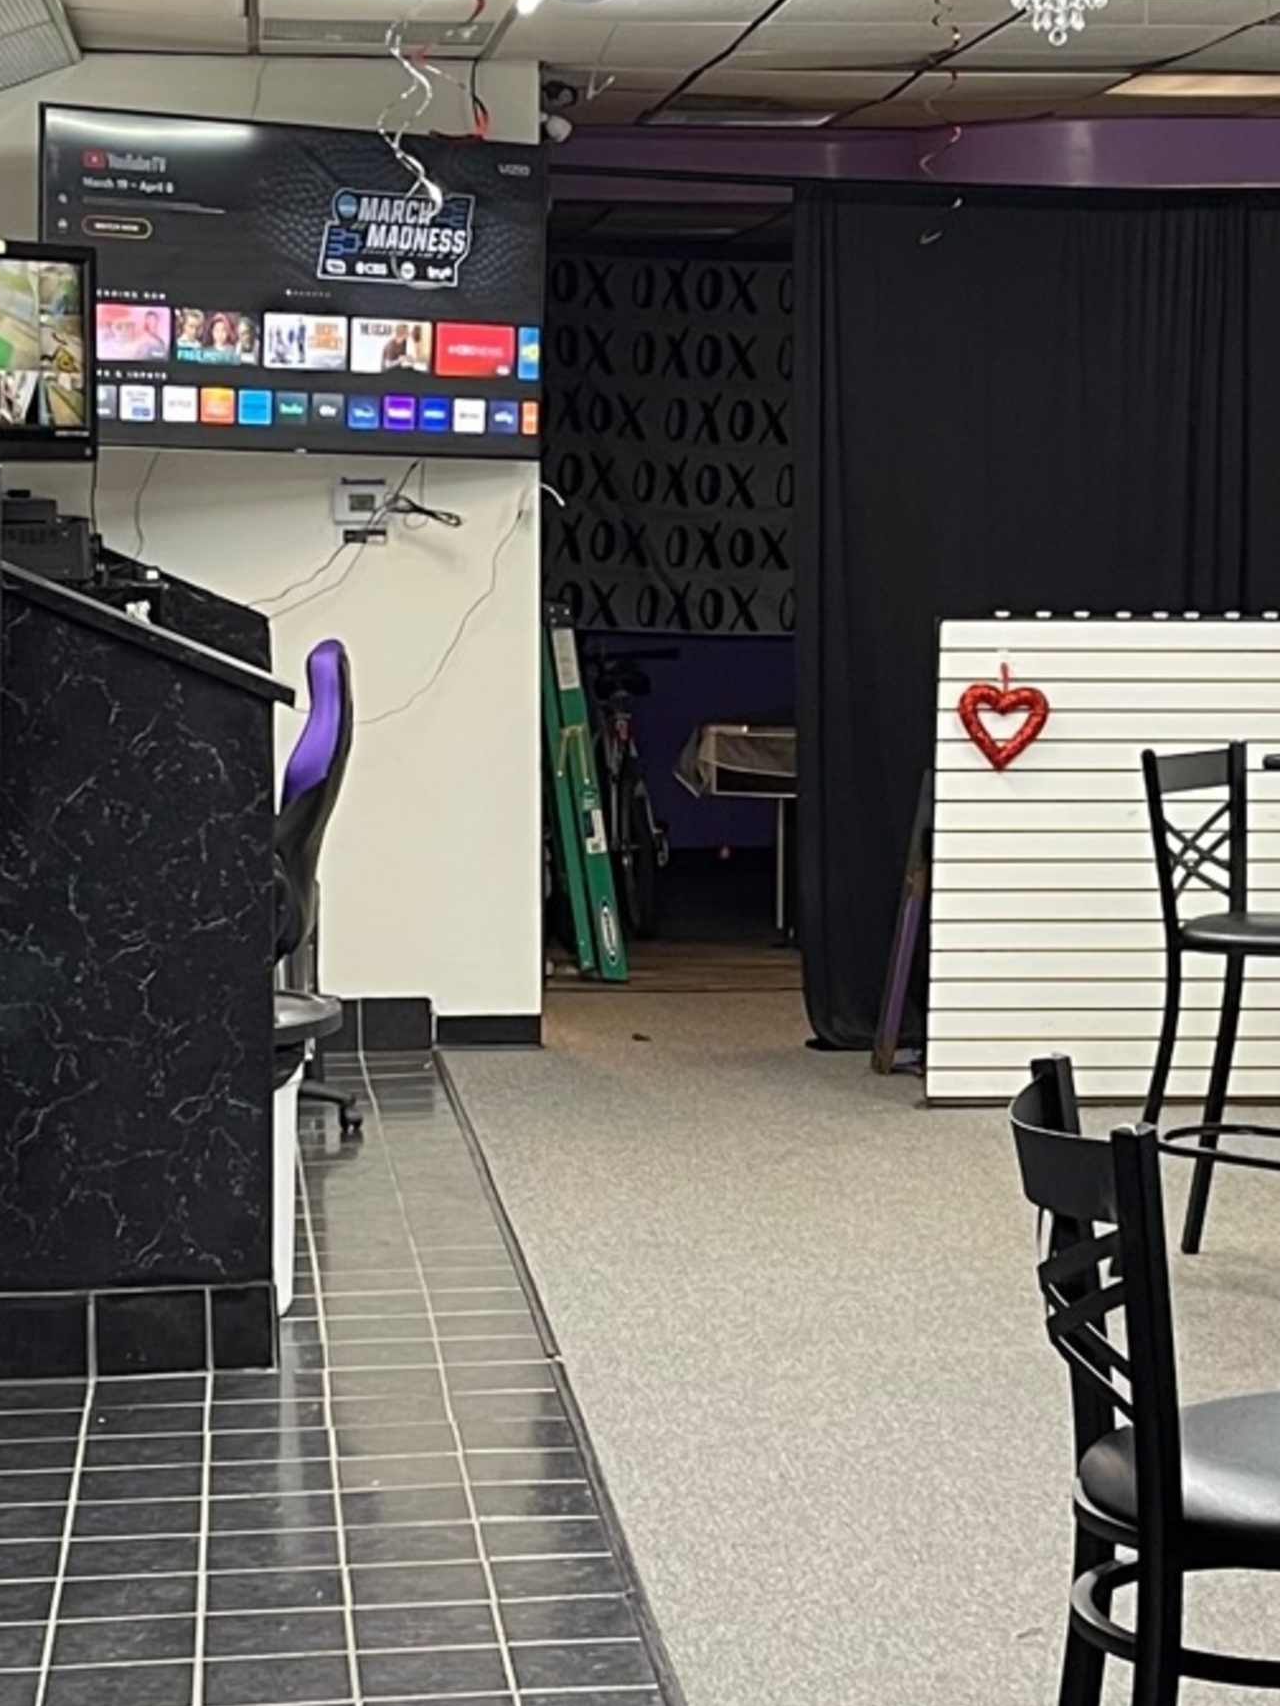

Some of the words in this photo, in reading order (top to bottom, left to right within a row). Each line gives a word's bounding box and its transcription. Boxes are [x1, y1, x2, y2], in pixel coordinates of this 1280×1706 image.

[83, 177, 114, 189] March
[139, 180, 163, 194] April
[358, 197, 433, 226] MARCH
[366, 224, 466, 254] MADNESS
